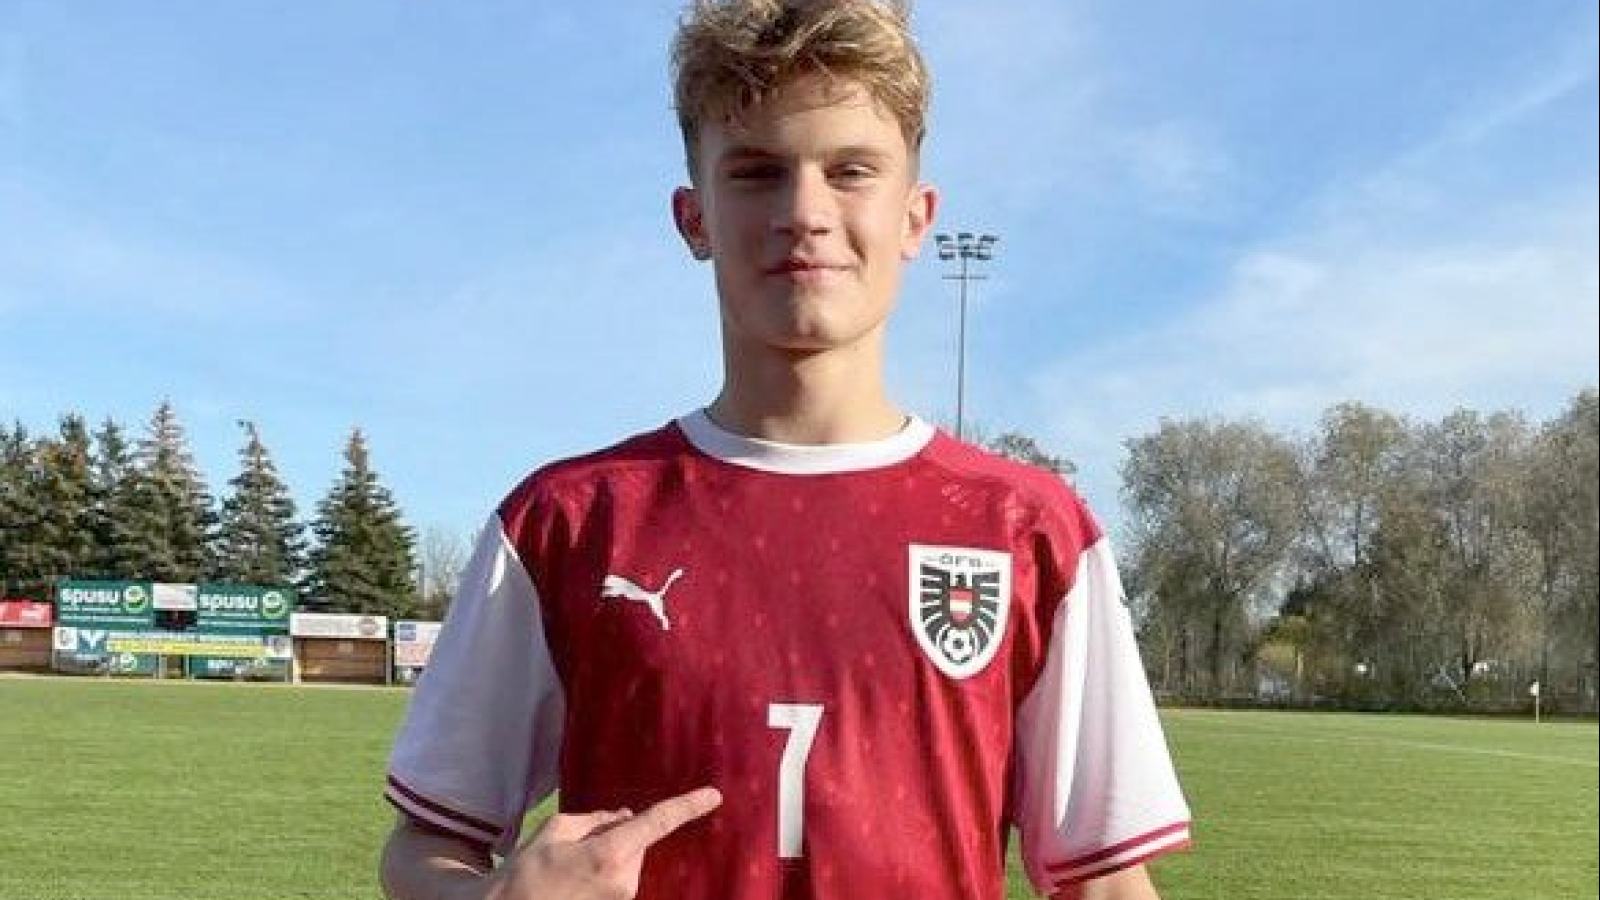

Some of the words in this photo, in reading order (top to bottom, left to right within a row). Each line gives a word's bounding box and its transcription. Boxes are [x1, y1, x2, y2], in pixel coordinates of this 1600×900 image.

[62, 588, 119, 606] spusu
[199, 594, 258, 612] spusu
[767, 703, 824, 858] 7
